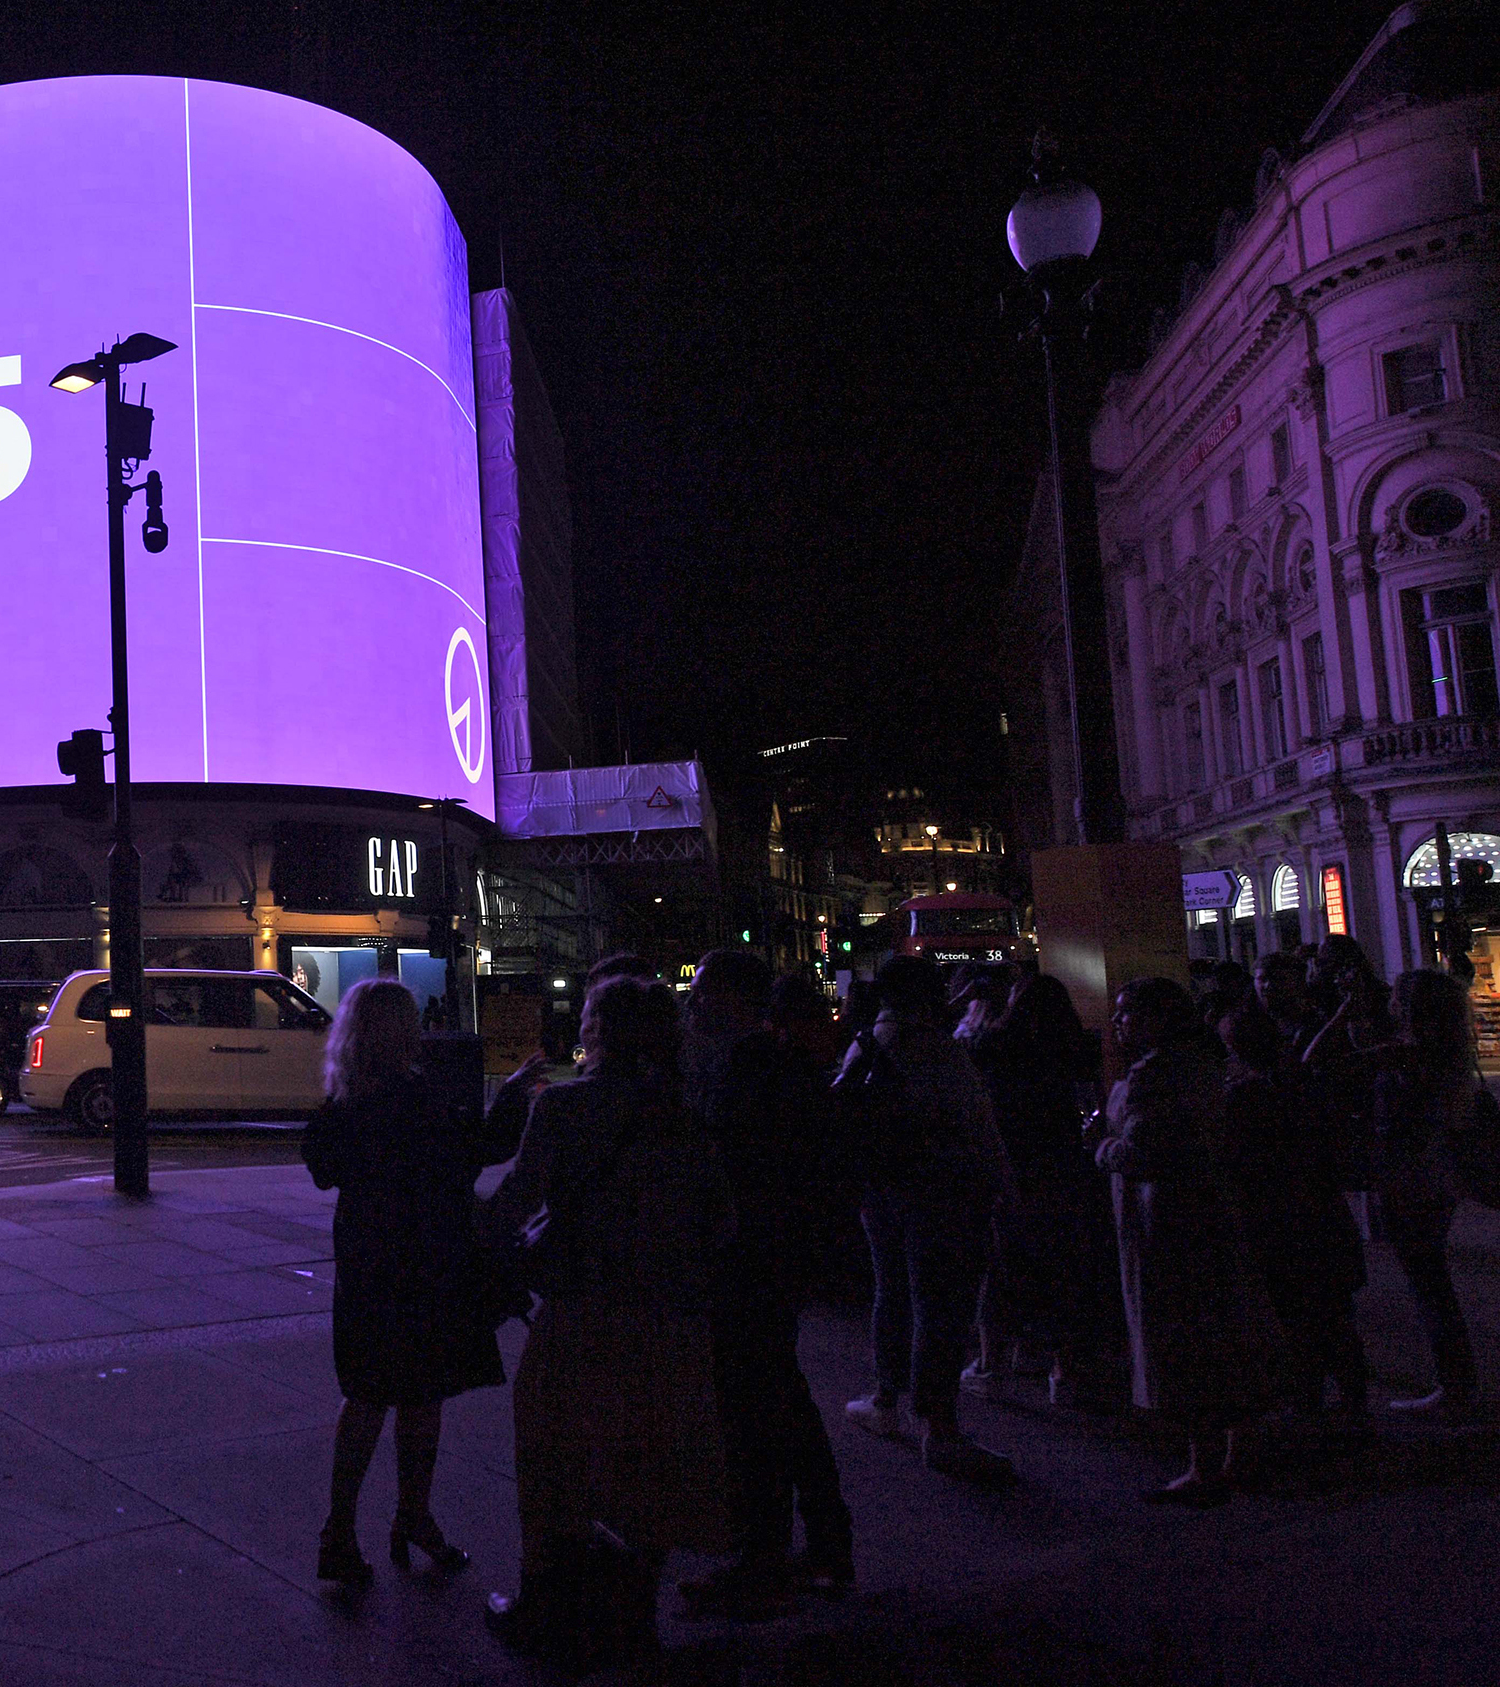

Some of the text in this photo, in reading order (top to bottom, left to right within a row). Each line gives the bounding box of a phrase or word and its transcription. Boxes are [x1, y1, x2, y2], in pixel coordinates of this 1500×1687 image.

[788, 740, 810, 751] POINT
[368, 837, 418, 898] GAP
[1199, 897, 1224, 905] Corner
[935, 949, 1003, 961] Victoria 38
[110, 1008, 131, 1018] WAIT
